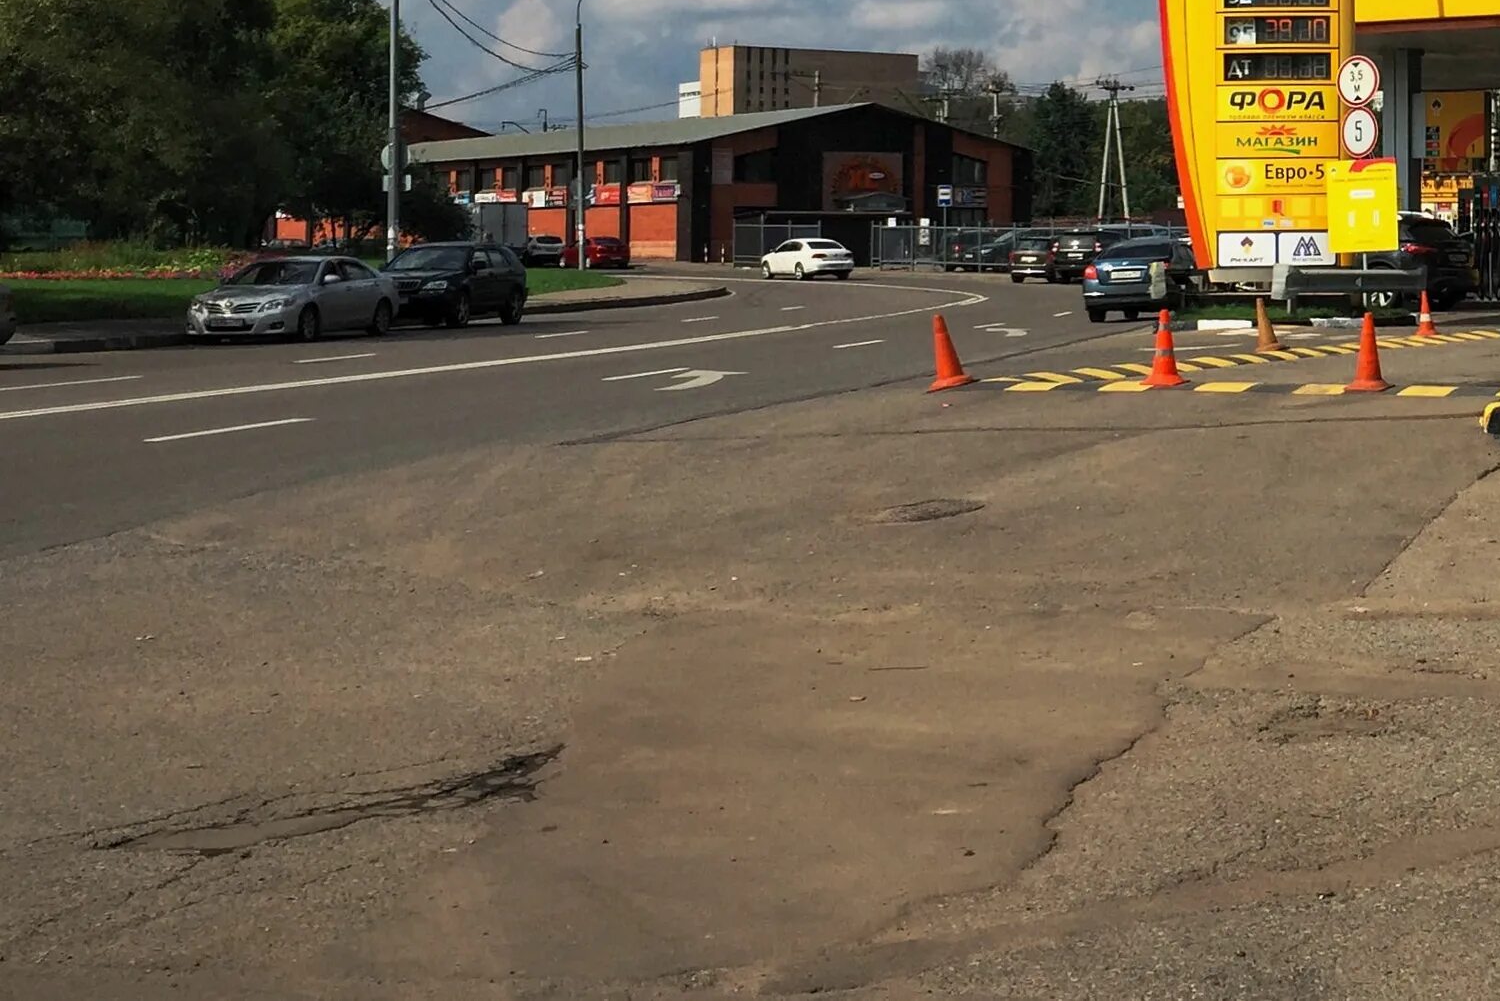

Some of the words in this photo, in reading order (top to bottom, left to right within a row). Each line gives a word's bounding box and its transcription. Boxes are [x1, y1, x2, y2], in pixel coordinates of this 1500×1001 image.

[1228, 59, 1252, 79] ДТ
[1229, 87, 1326, 113] ФОРА
[1235, 136, 1318, 147] МАГАЗИН
[1354, 120, 1363, 142] 5
